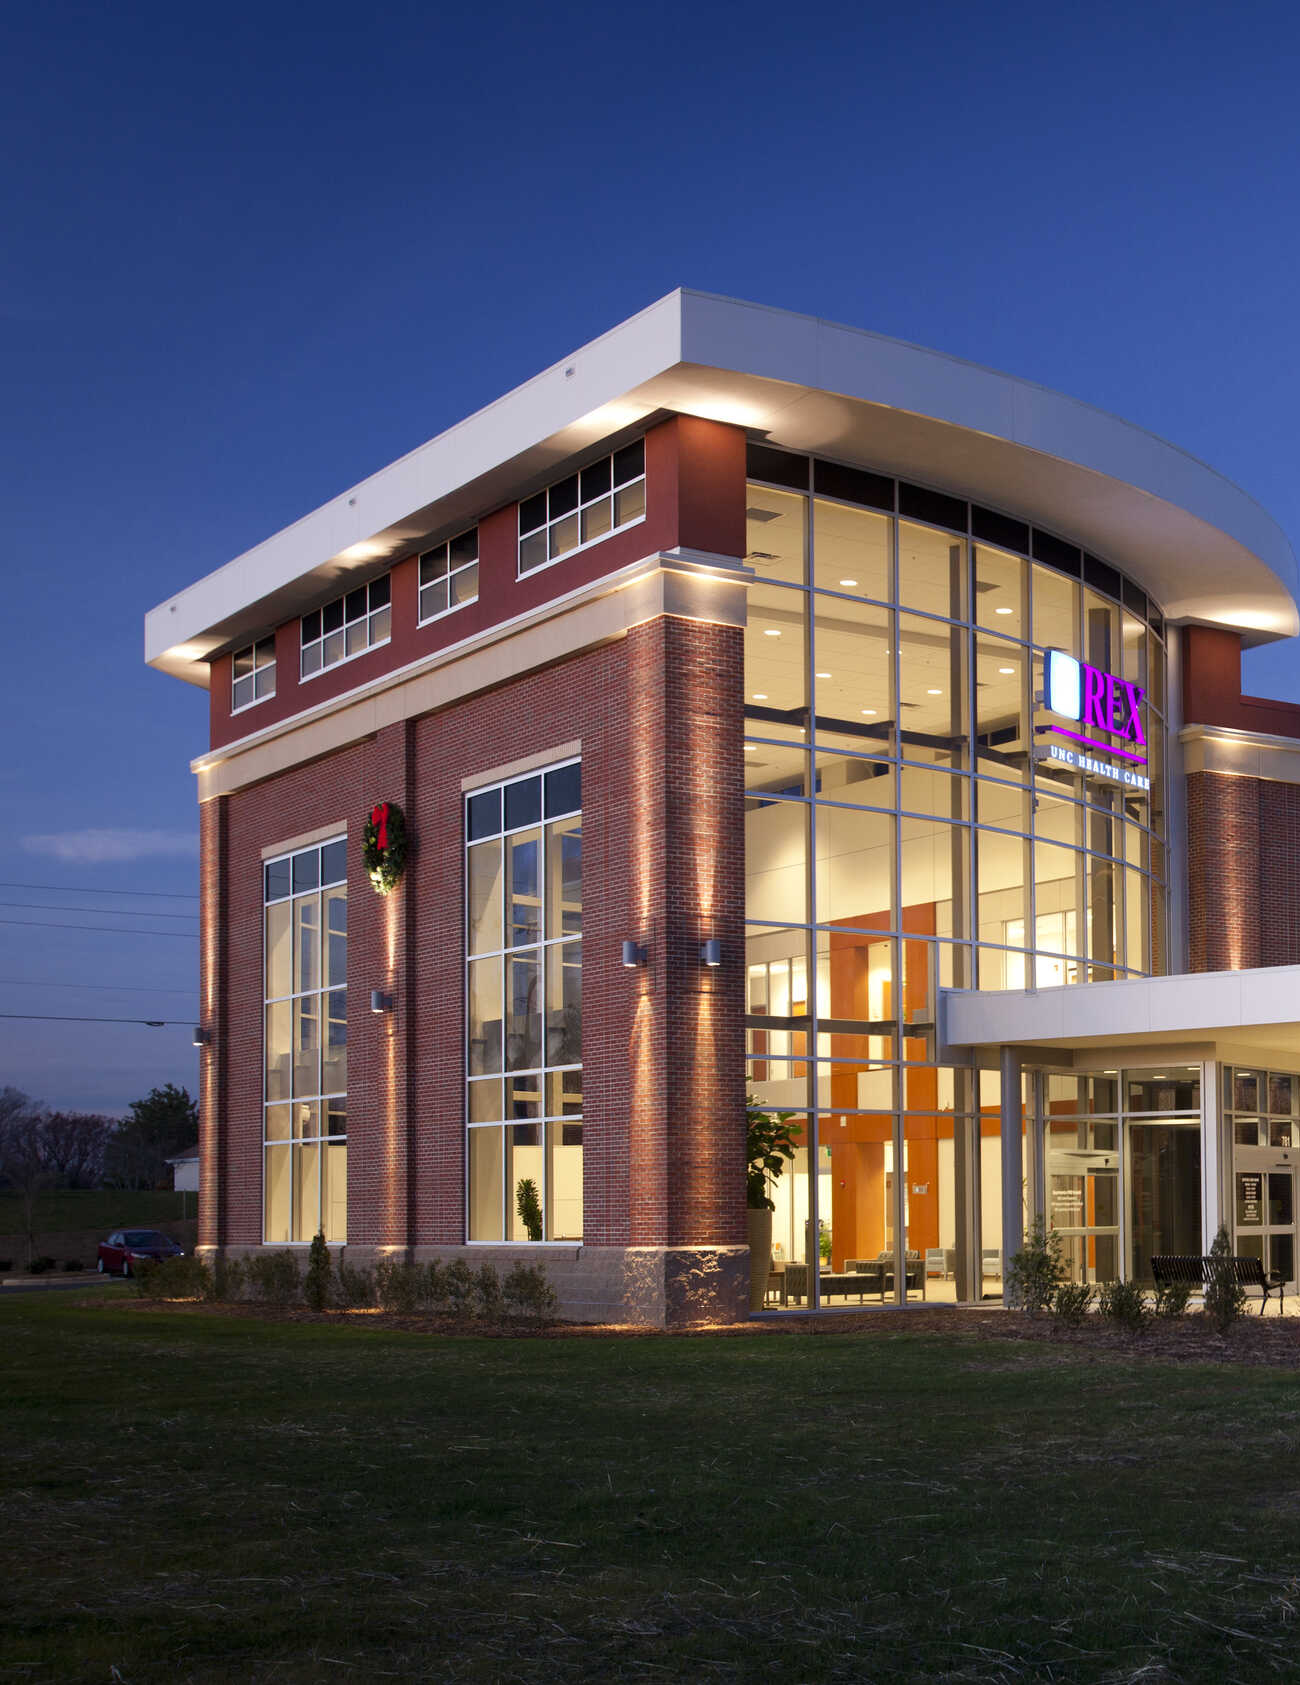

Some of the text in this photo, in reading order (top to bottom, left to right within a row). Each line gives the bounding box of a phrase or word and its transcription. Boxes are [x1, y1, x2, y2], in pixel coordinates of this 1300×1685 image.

[1083, 663, 1147, 746] REX
[1050, 745, 1150, 790] UNC HEALTH CARE
